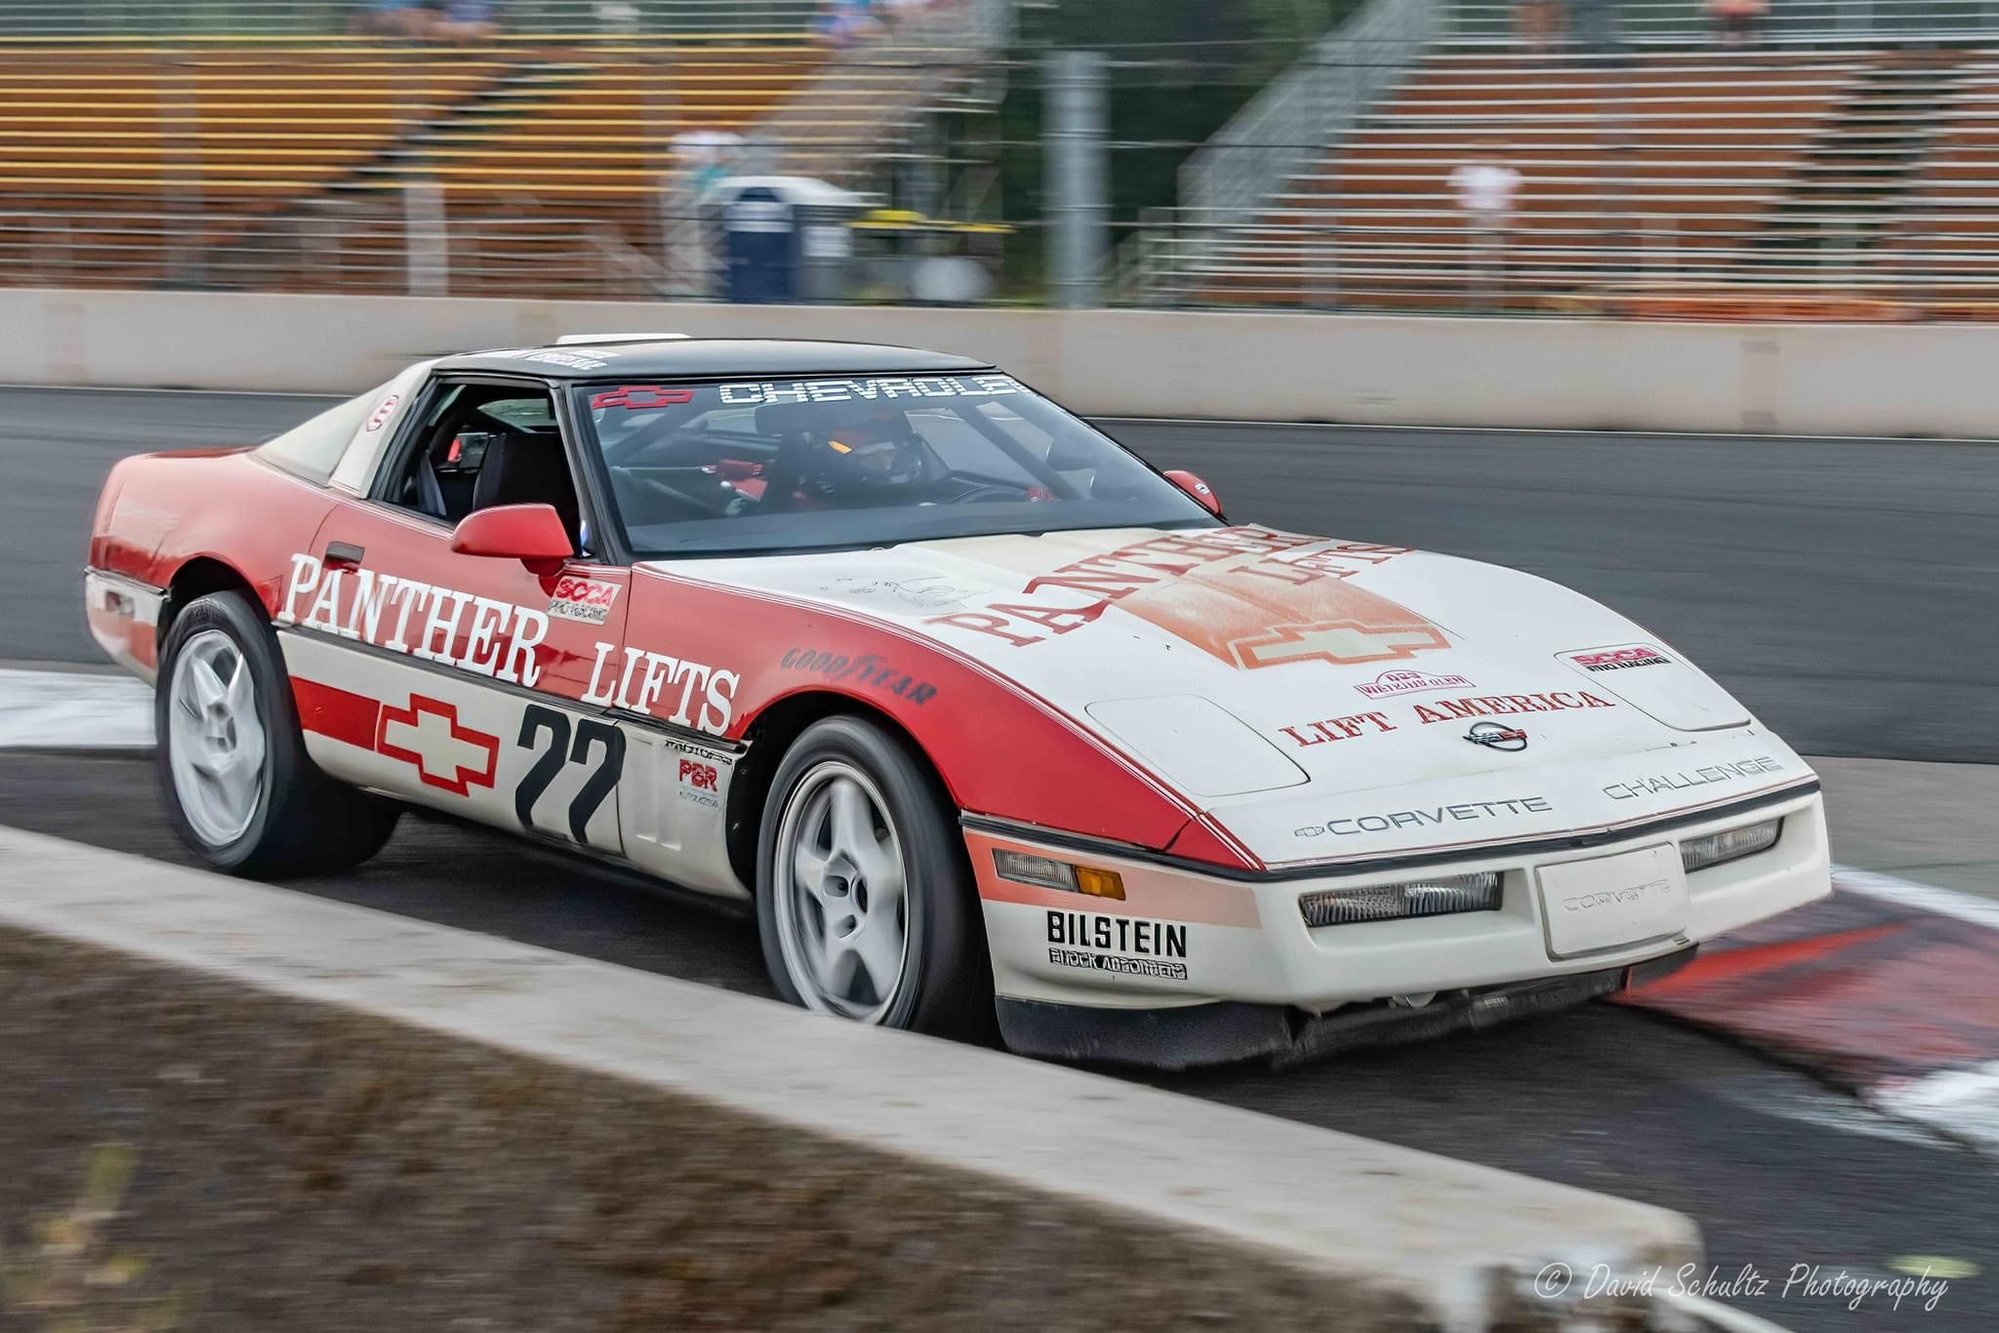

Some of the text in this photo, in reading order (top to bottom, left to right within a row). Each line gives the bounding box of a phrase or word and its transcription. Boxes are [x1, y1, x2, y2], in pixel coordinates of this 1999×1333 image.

[922, 526, 1331, 647] PANTHER
[277, 552, 741, 737] PANTHER LIFTS
[1279, 691, 1616, 748] LIFT AMERICA
[1328, 755, 1785, 836] CORVETTE CHALLENGE
[1047, 910, 1187, 958] BILSTEIN
